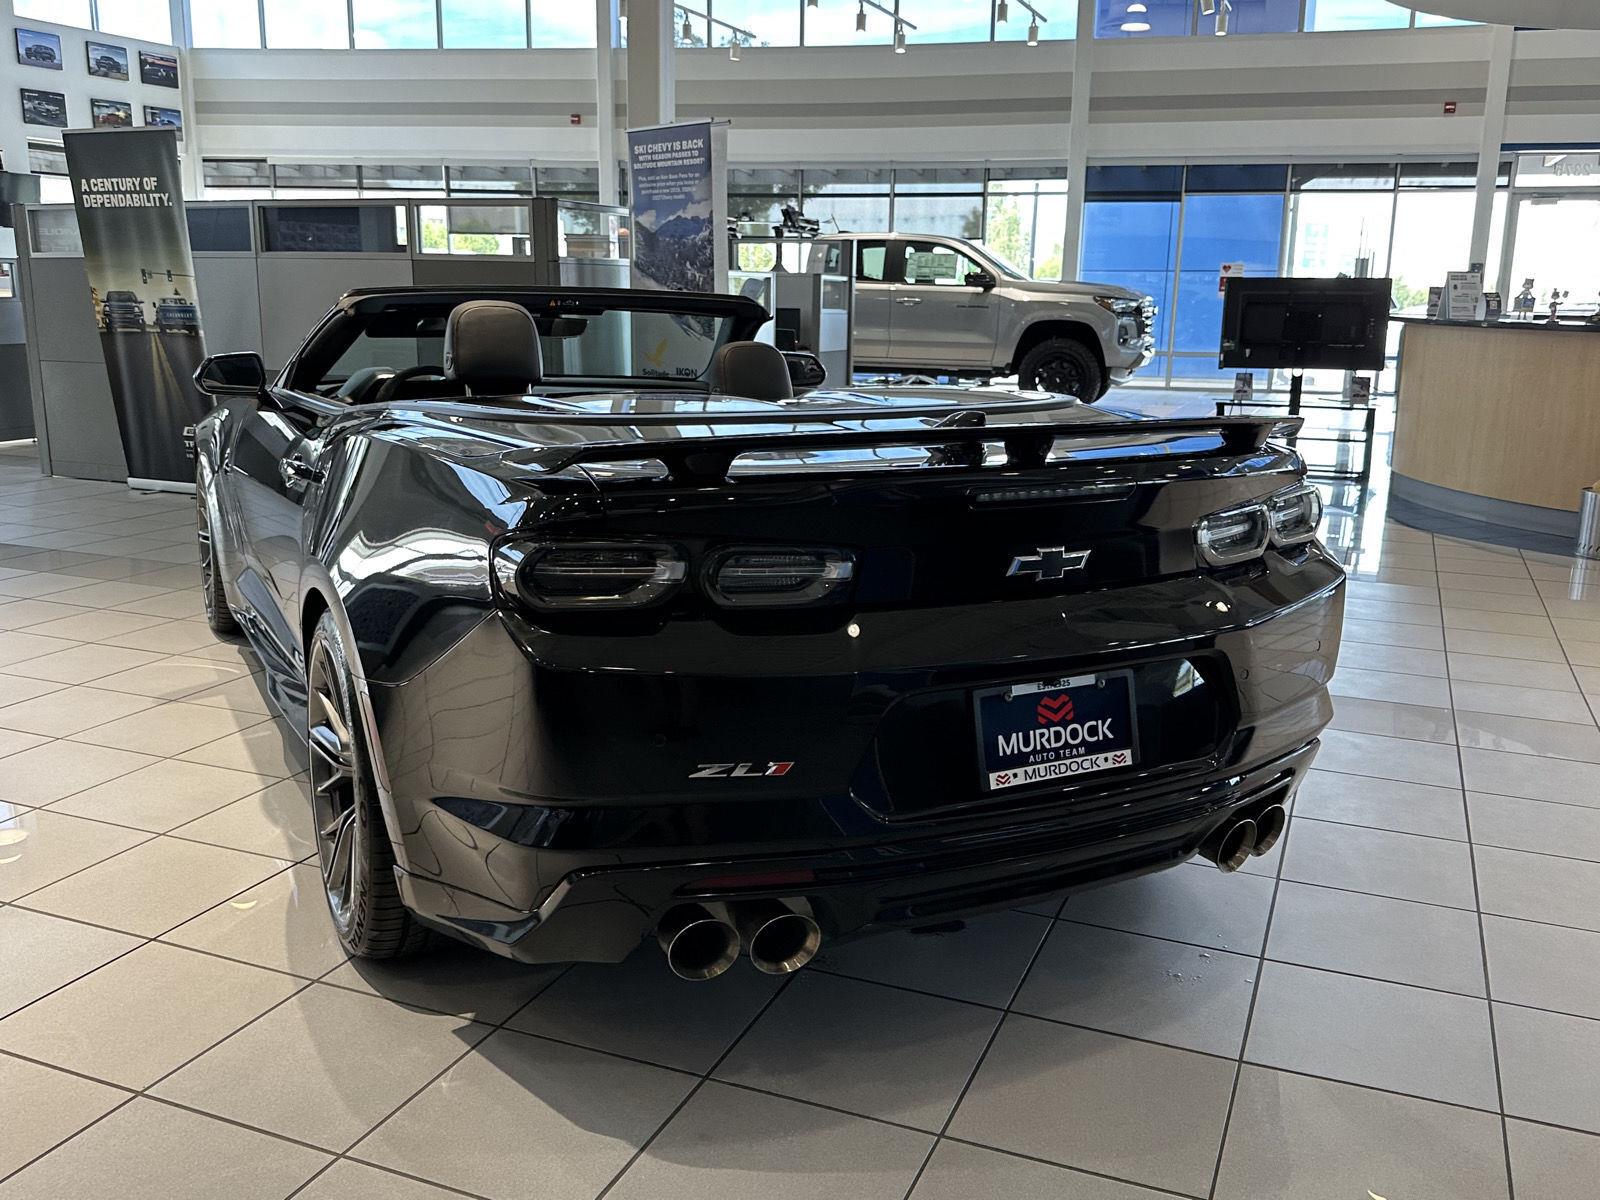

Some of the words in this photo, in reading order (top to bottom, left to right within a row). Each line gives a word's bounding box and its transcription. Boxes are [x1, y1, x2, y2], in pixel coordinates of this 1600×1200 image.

[634, 144, 646, 154] SKI
[647, 142, 672, 153] CHEVY
[673, 141, 681, 151] IS
[682, 139, 704, 150] BACK
[652, 152, 671, 160] SEASON
[81, 178, 90, 192] A
[90, 177, 140, 192] CENTURY
[142, 176, 158, 191] OF
[82, 192, 173, 208] DEPENDABILITY.
[676, 367, 698, 378] IKON
[997, 718, 1114, 757] MURDOCK
[1028, 751, 1055, 763] AUTO
[1060, 746, 1086, 758] TEAM
[688, 761, 795, 778] ZL1
[1024, 756, 1101, 781] MURDOCK
